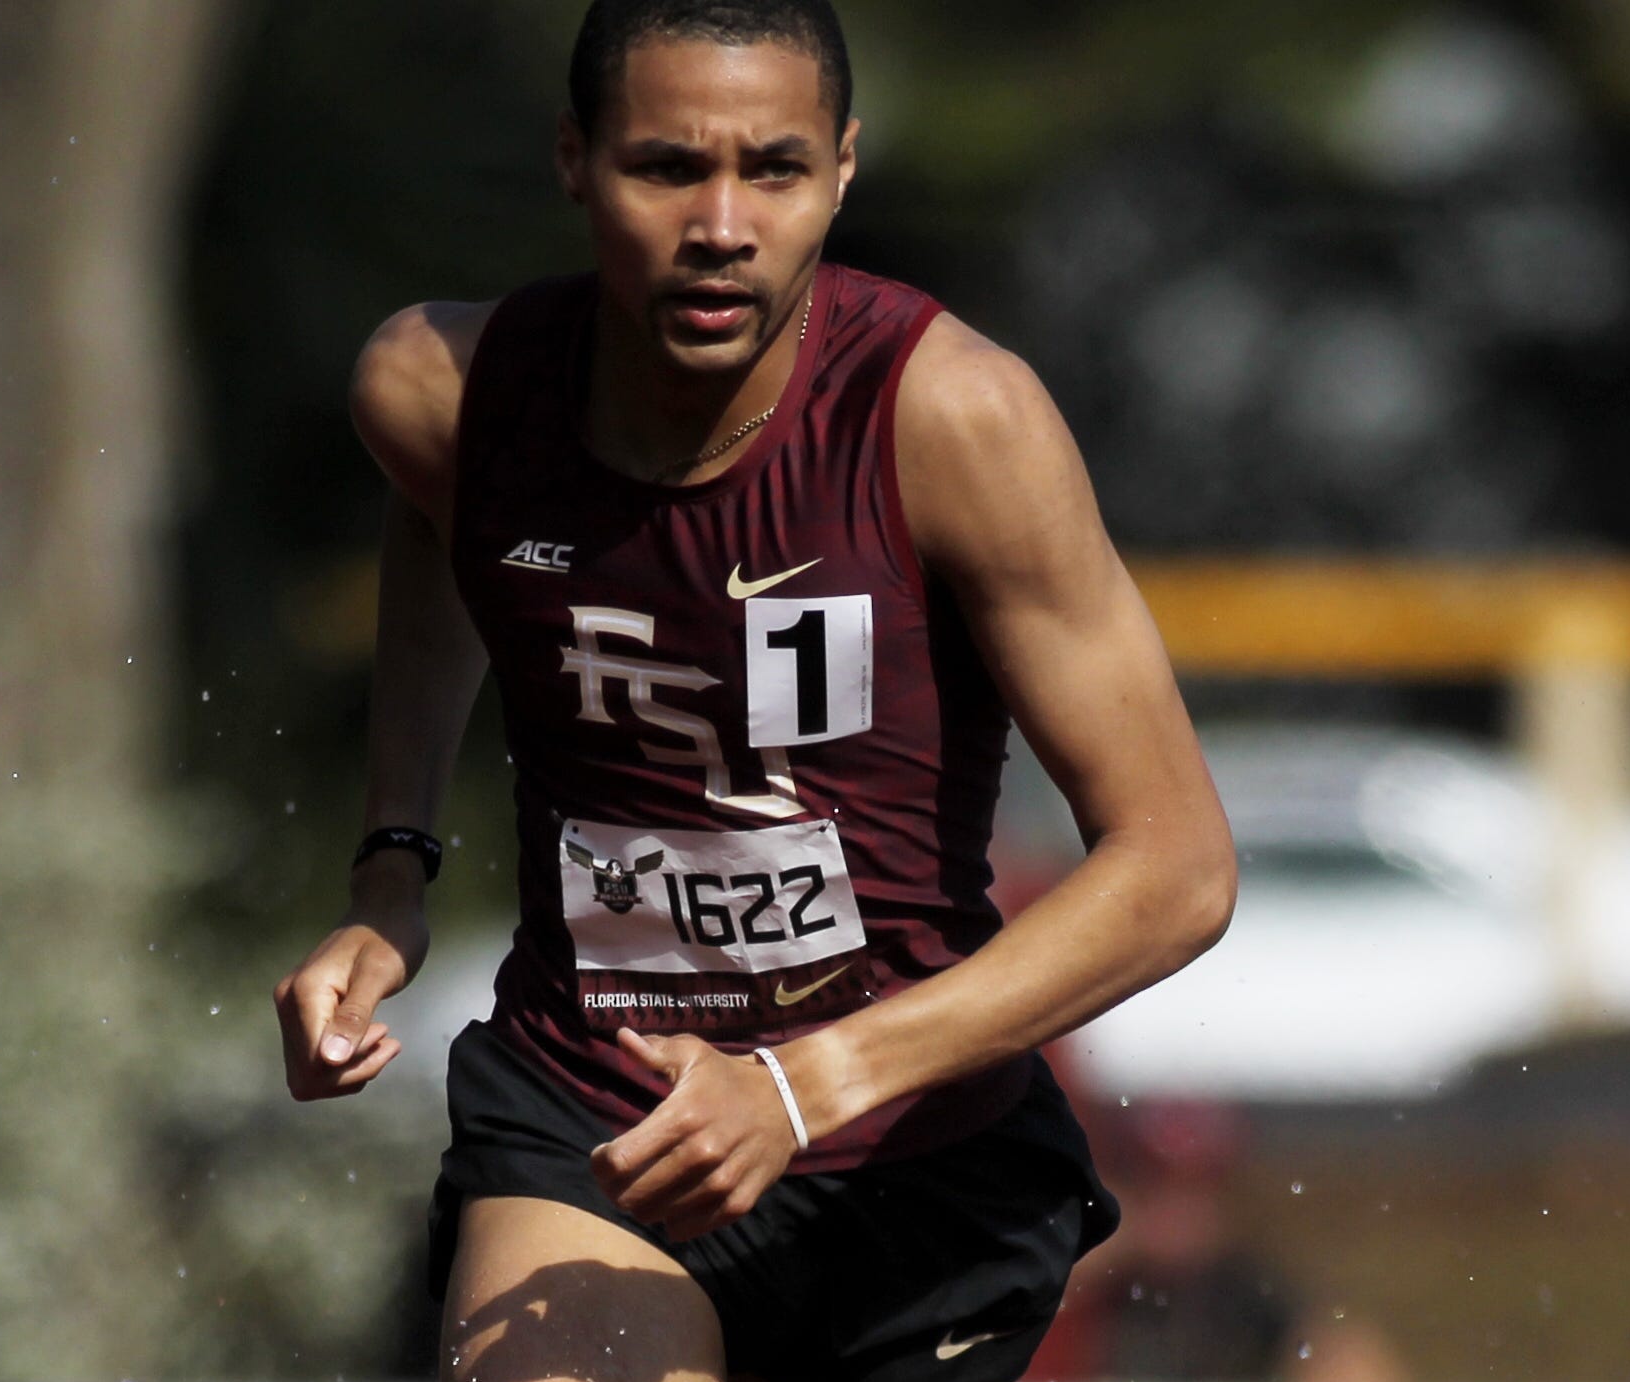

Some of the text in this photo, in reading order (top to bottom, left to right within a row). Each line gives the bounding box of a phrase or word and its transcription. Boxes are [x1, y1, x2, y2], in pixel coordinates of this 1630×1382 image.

[506, 540, 575, 567] ACC
[766, 610, 828, 736] 1
[662, 864, 837, 947] 1622
[584, 993, 638, 1008] FLORIDA
[639, 993, 674, 1008] STATE
